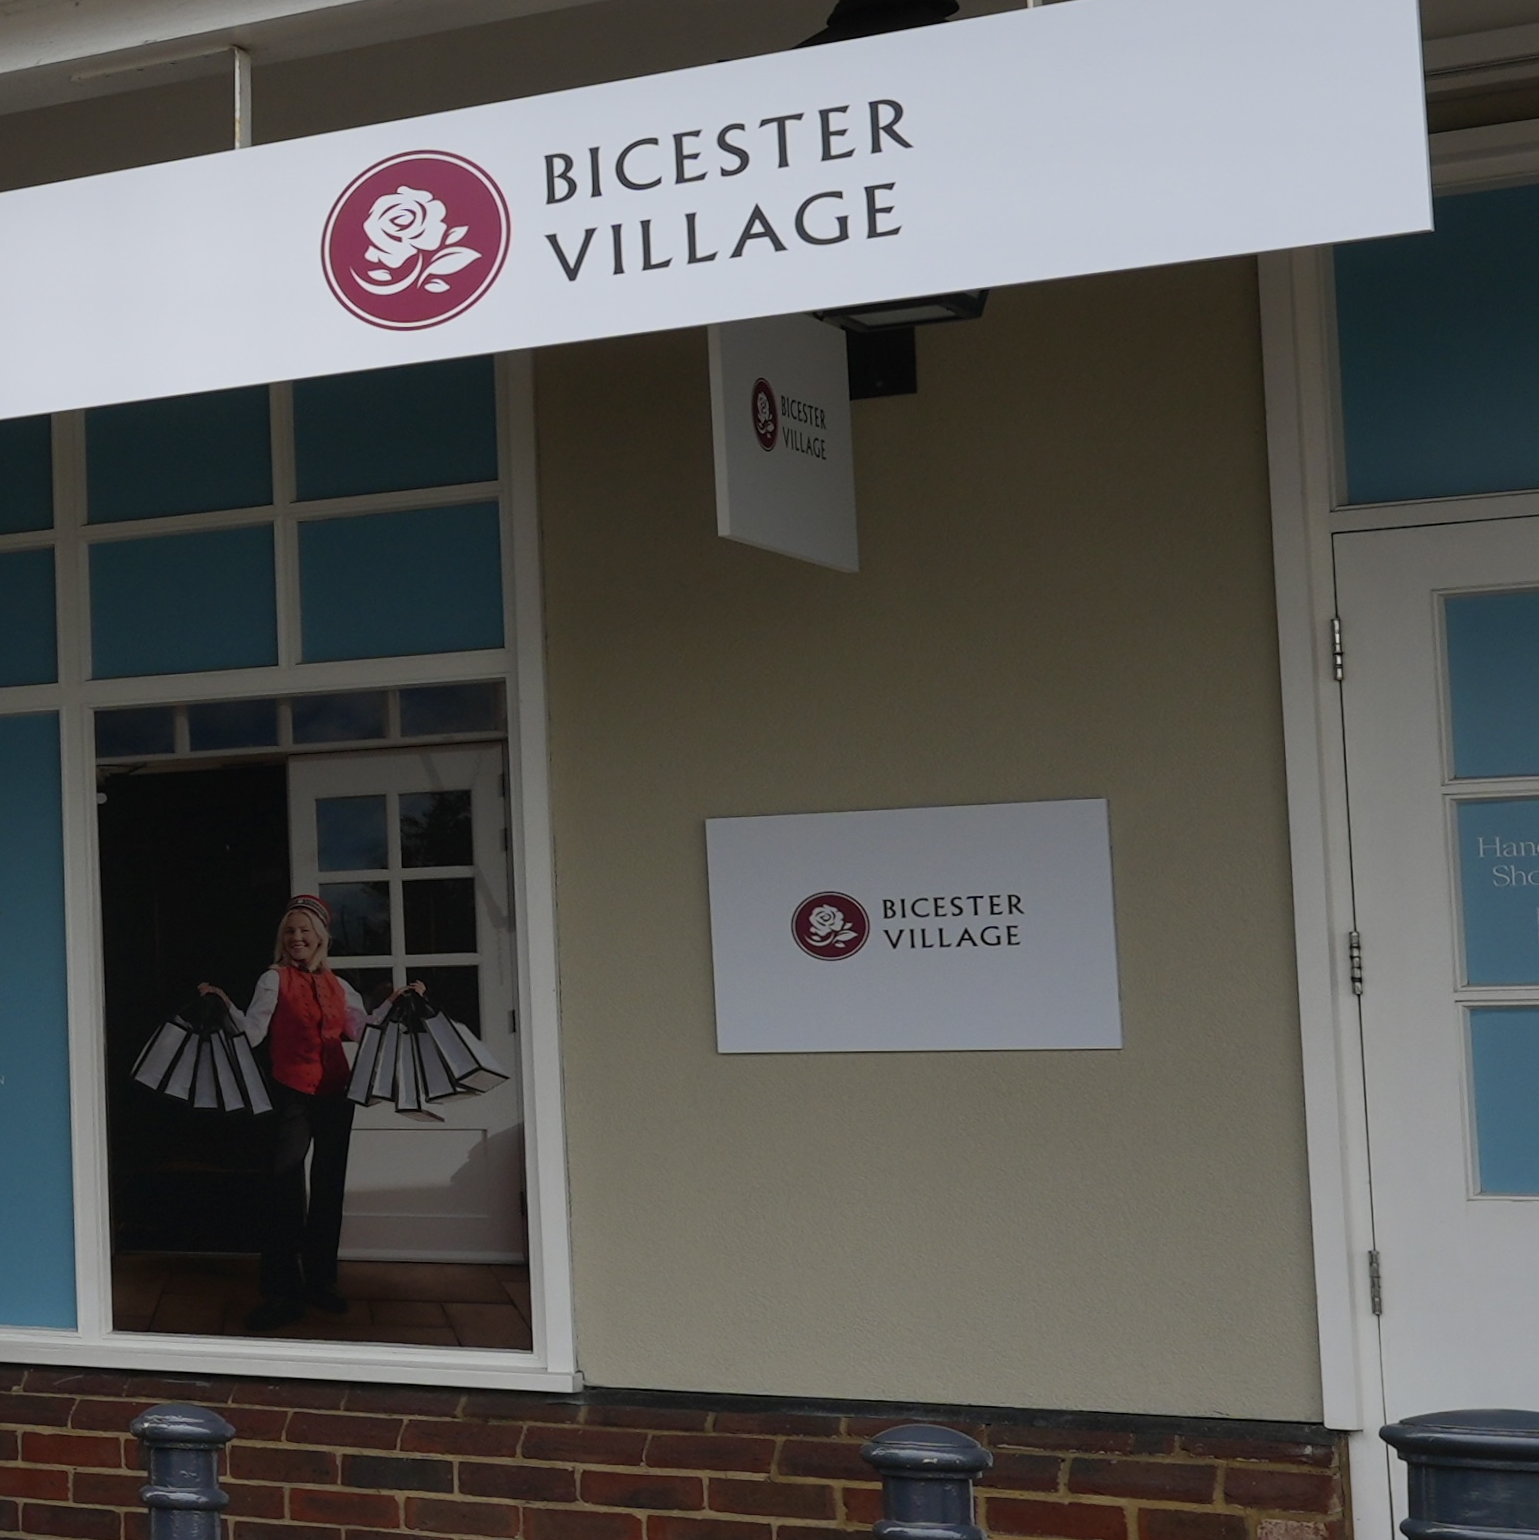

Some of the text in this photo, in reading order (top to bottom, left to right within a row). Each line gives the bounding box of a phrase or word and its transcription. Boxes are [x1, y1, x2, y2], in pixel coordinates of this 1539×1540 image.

[543, 98, 914, 206] BICESTER
[544, 181, 903, 282] VILLAGE
[781, 394, 826, 430] BICESTER
[782, 426, 826, 460] VILLAGE
[1477, 836, 1539, 858] Han
[882, 894, 1025, 919] BICESTER
[883, 925, 1021, 950] VILLAGE
